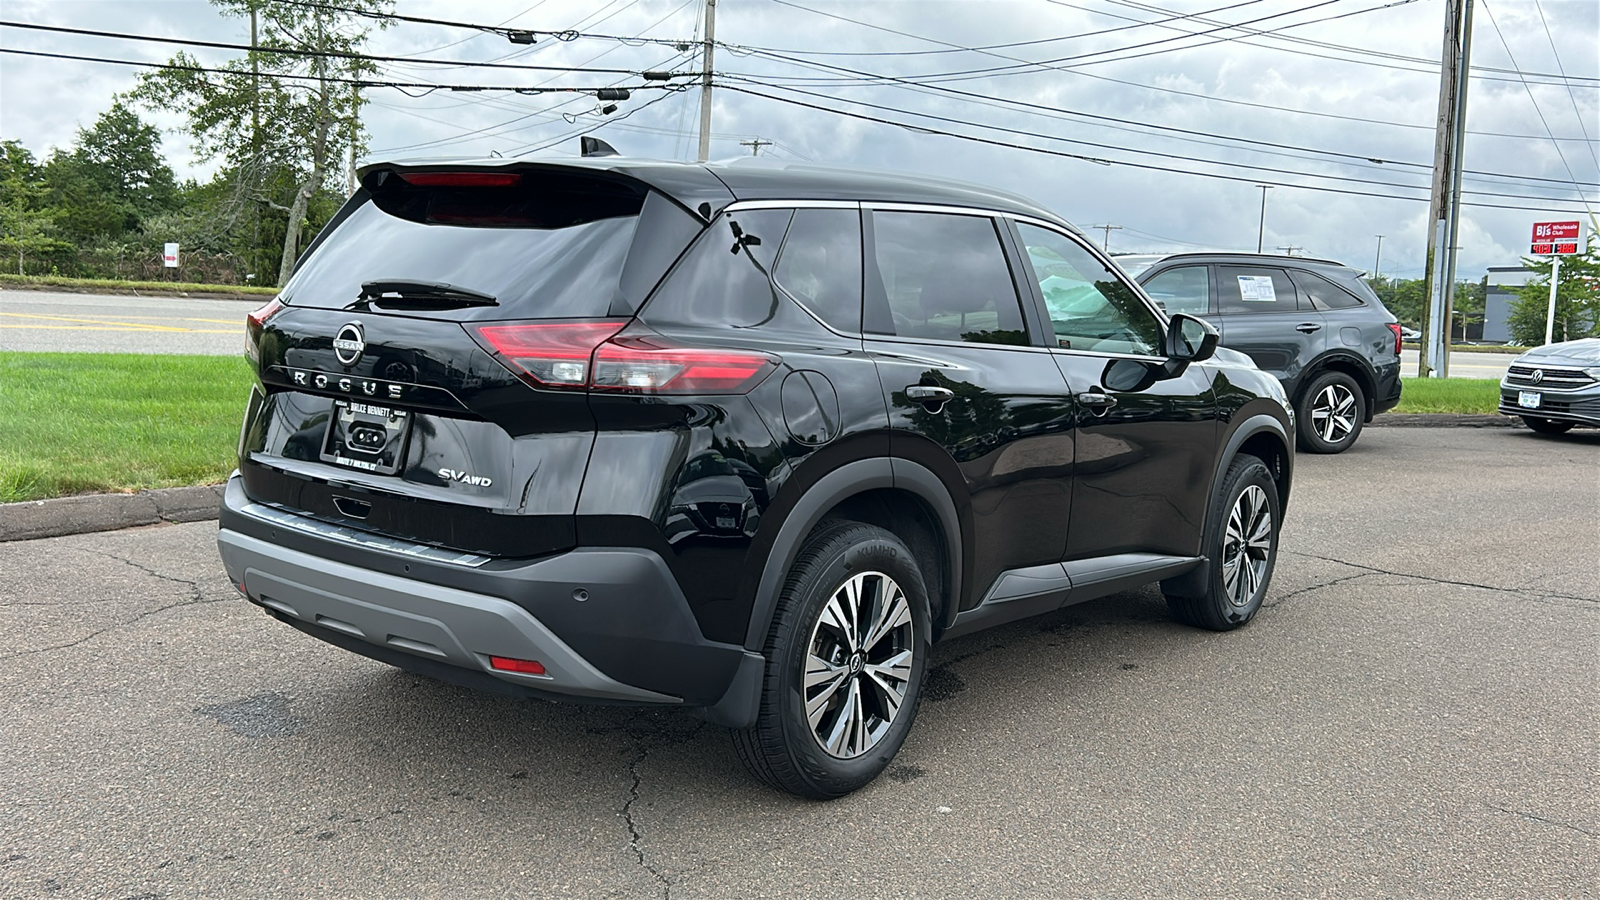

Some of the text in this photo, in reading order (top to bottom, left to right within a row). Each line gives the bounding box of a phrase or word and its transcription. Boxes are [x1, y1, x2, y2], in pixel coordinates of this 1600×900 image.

[1536, 223, 1551, 237] BJ's
[333, 340, 364, 350] NISSAN
[294, 371, 402, 398] ROGUE
[351, 402, 390, 417] BRUCE BENNETT
[438, 468, 492, 487] SV AWD
[857, 545, 897, 558] KUMHO
